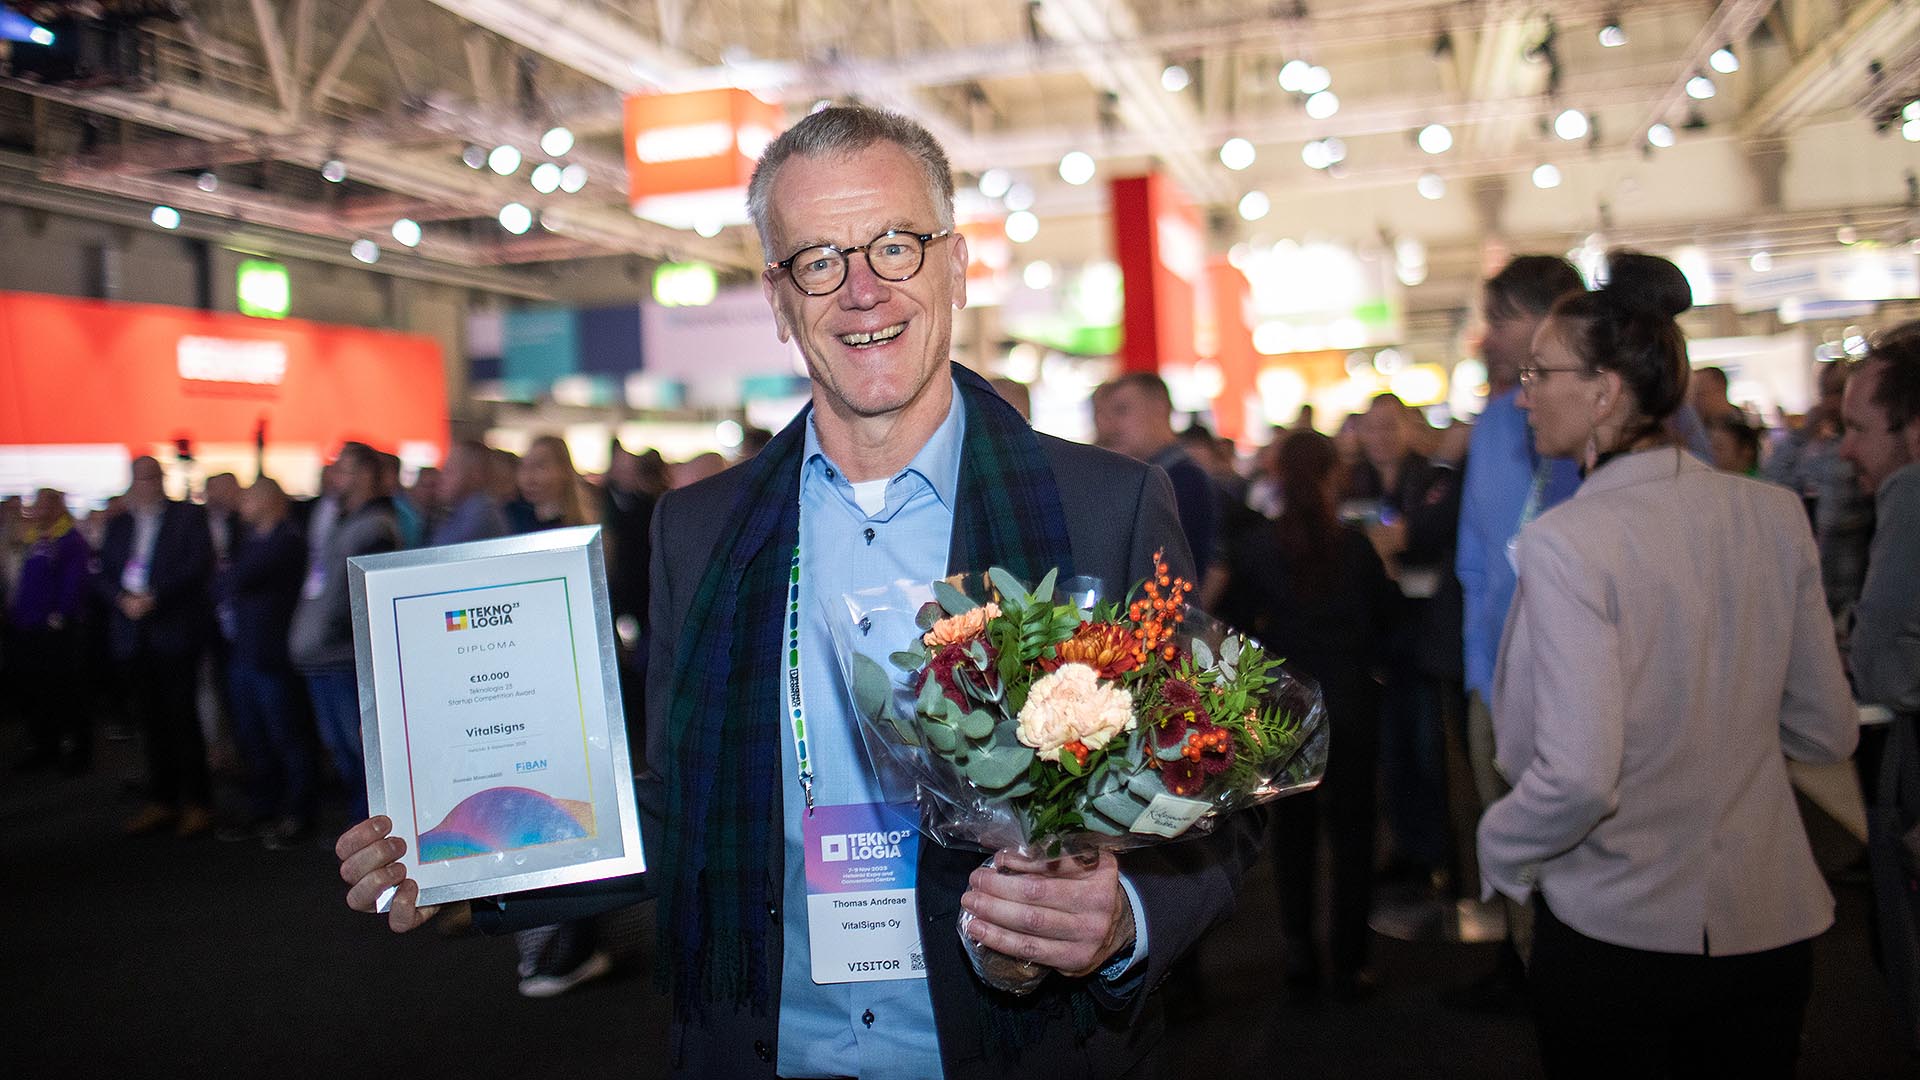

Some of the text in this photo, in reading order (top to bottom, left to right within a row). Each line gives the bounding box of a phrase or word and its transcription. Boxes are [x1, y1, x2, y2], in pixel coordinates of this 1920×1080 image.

[471, 615, 513, 629] LOGIA
[457, 640, 516, 655] DIPLOMA
[470, 671, 510, 683] €10.000
[469, 685, 504, 695] Teknologia
[448, 689, 536, 707] Startup Competition Award
[465, 723, 525, 738] VitalSigns
[515, 759, 548, 771] FiBAN
[851, 845, 902, 861] LOGIA
[832, 897, 907, 909] Thomas Andreae
[842, 919, 901, 931] VitalSigns Oy
[847, 960, 901, 972] VISITOR
